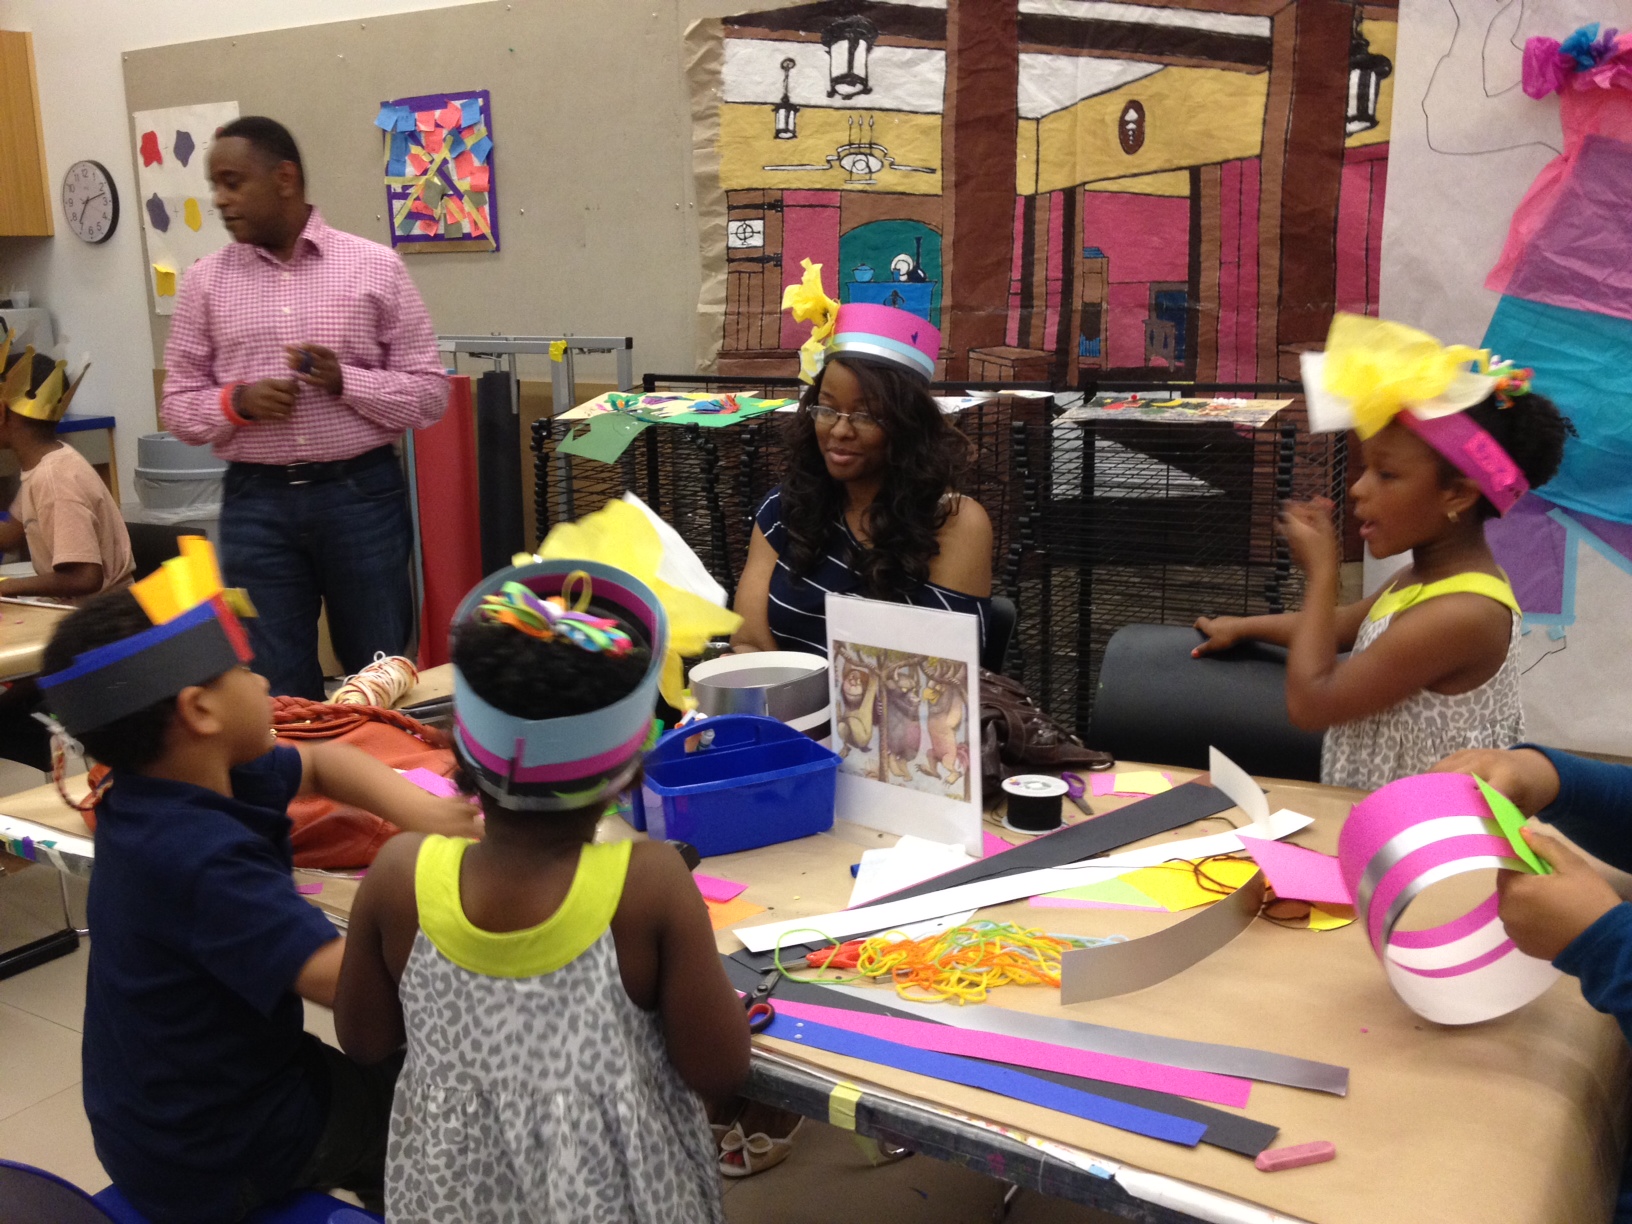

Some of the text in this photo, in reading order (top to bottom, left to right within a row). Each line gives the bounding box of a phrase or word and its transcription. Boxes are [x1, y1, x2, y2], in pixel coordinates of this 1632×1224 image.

[81, 168, 89, 178] 12
[68, 198, 74, 207] 9
[102, 197, 108, 206] 3
[72, 212, 78, 221] 8
[102, 212, 108, 220] 4
[88, 226, 94, 235] 6
[96, 221, 102, 231] 5
